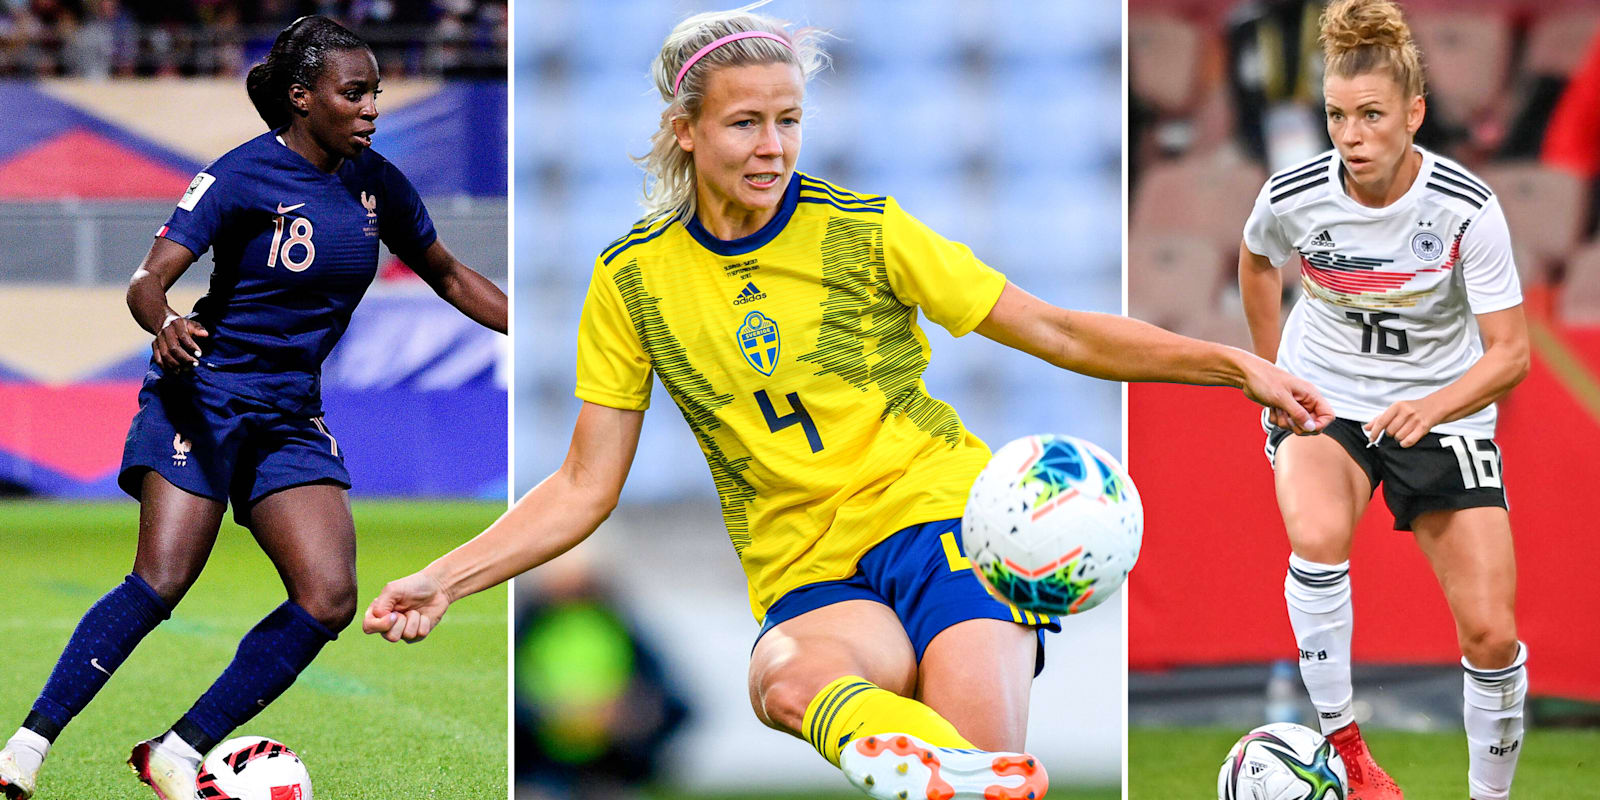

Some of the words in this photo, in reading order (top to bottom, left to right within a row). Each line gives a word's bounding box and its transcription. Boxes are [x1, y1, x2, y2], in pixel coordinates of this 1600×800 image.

[267, 215, 316, 272] 18
[733, 293, 767, 306] adidas
[1345, 311, 1410, 355] 16
[753, 389, 825, 454] 4
[1439, 435, 1502, 490] 16
